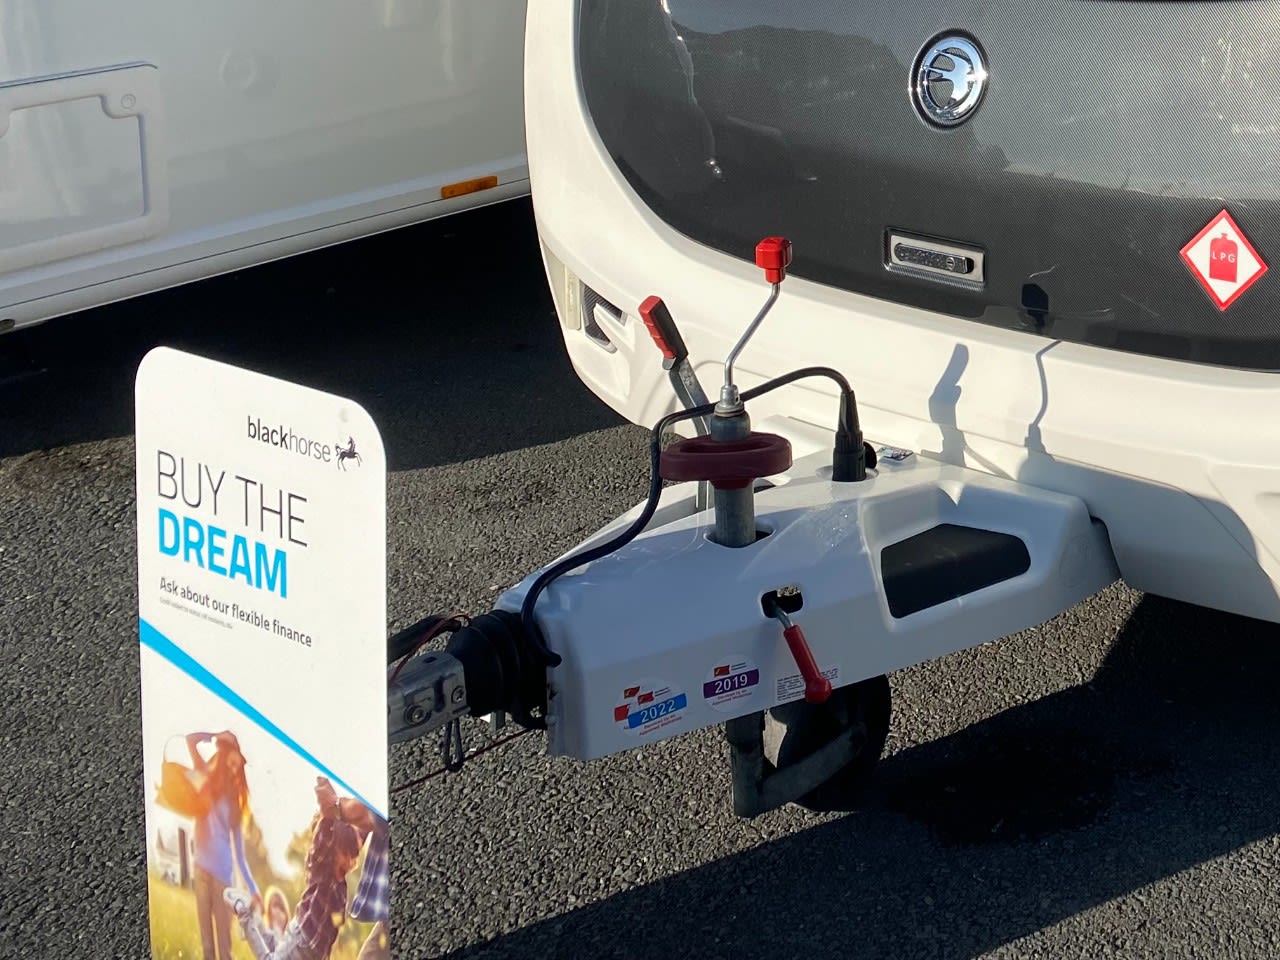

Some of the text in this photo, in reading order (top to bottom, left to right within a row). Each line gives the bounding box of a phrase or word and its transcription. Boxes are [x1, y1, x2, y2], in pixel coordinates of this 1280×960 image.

[247, 415, 331, 463] blackhorse
[157, 449, 308, 548] BUY THE
[158, 507, 288, 600] DREAM
[159, 576, 179, 596] Ask
[180, 585, 211, 609] about
[212, 598, 230, 616] our
[232, 603, 270, 632] flexible
[272, 618, 312, 648] finance
[640, 699, 676, 723] 2022
[714, 673, 748, 694] 2019
